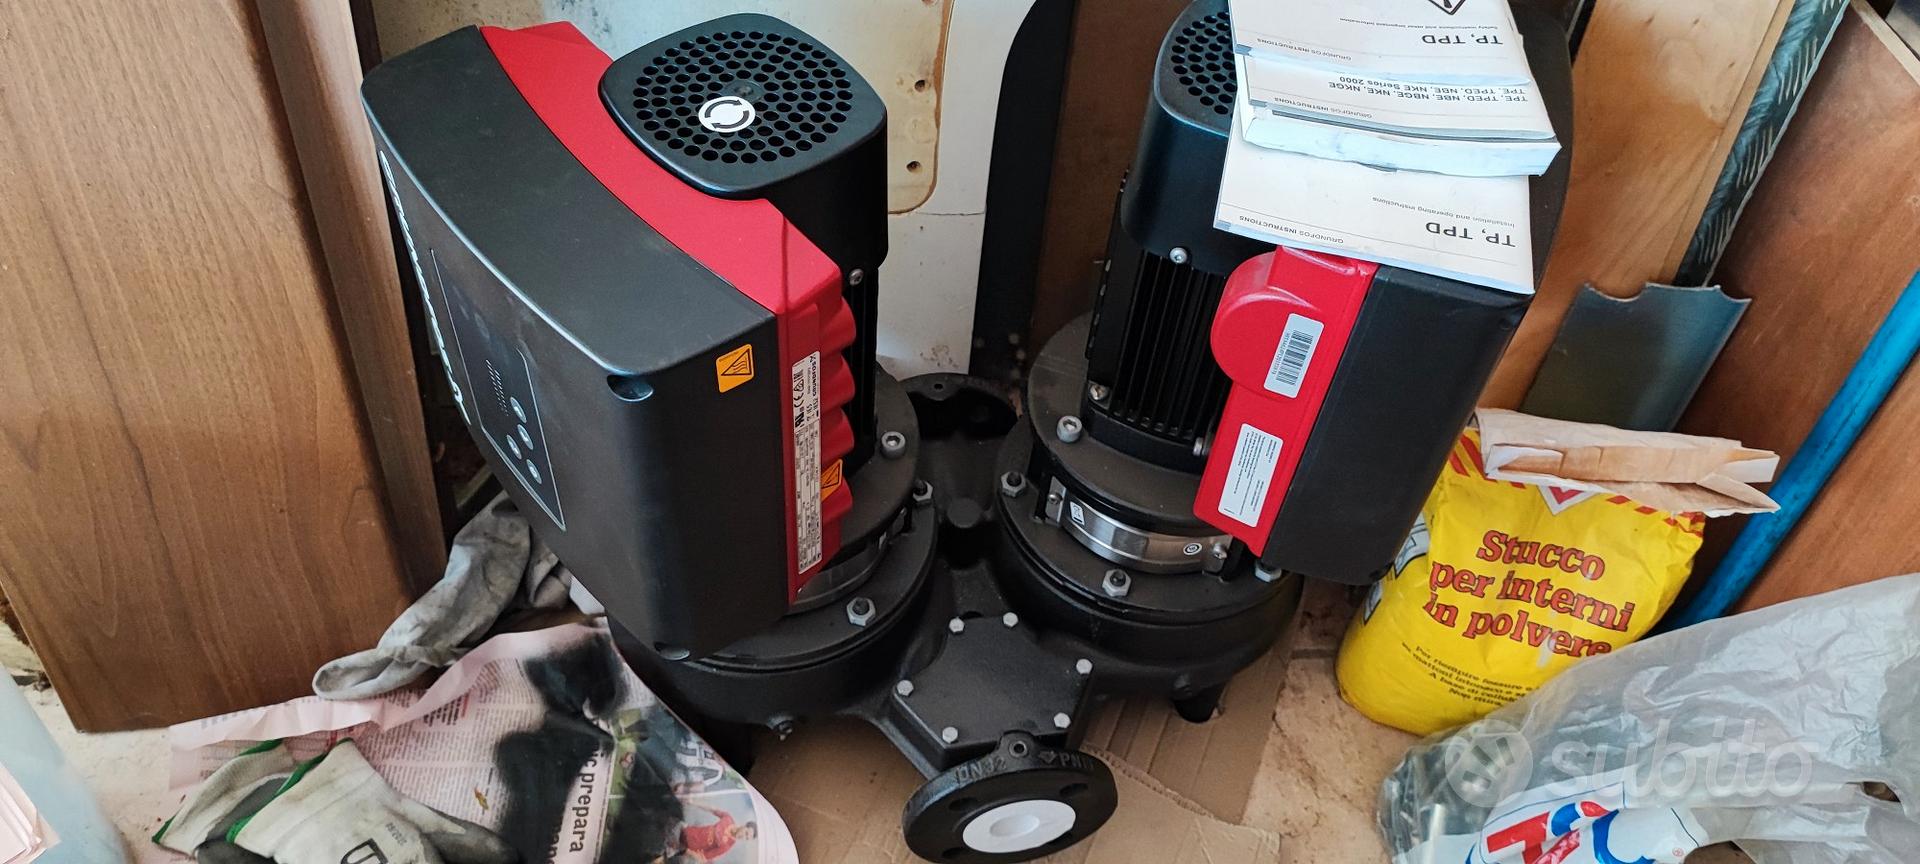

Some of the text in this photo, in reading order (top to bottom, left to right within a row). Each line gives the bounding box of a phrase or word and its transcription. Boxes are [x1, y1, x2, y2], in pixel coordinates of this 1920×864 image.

[1257, 38, 1352, 61] GRUNDFOS INSTRUCTIONS
[1421, 33, 1504, 45] TP, TPD
[1328, 81, 1528, 102] TPE, TPED, NBE, NBGE, NKE, NKGE
[1339, 76, 1364, 86] 2000
[1367, 79, 1401, 90] Series
[1404, 84, 1427, 92] NKE
[1274, 97, 1373, 119] GRUNDFOS INSTRUCTIONS
[1372, 196, 1515, 228] Installation and operating instructions
[1239, 215, 1344, 244] GRUNDFOS INSTRUCTIONS
[1425, 221, 1516, 248] TP, TPD
[1476, 529, 1606, 581] Stucco
[1429, 561, 1635, 632] per interni
[1422, 593, 1612, 658] in polvere
[956, 755, 1007, 783] DN32
[569, 772, 595, 853] prepara
